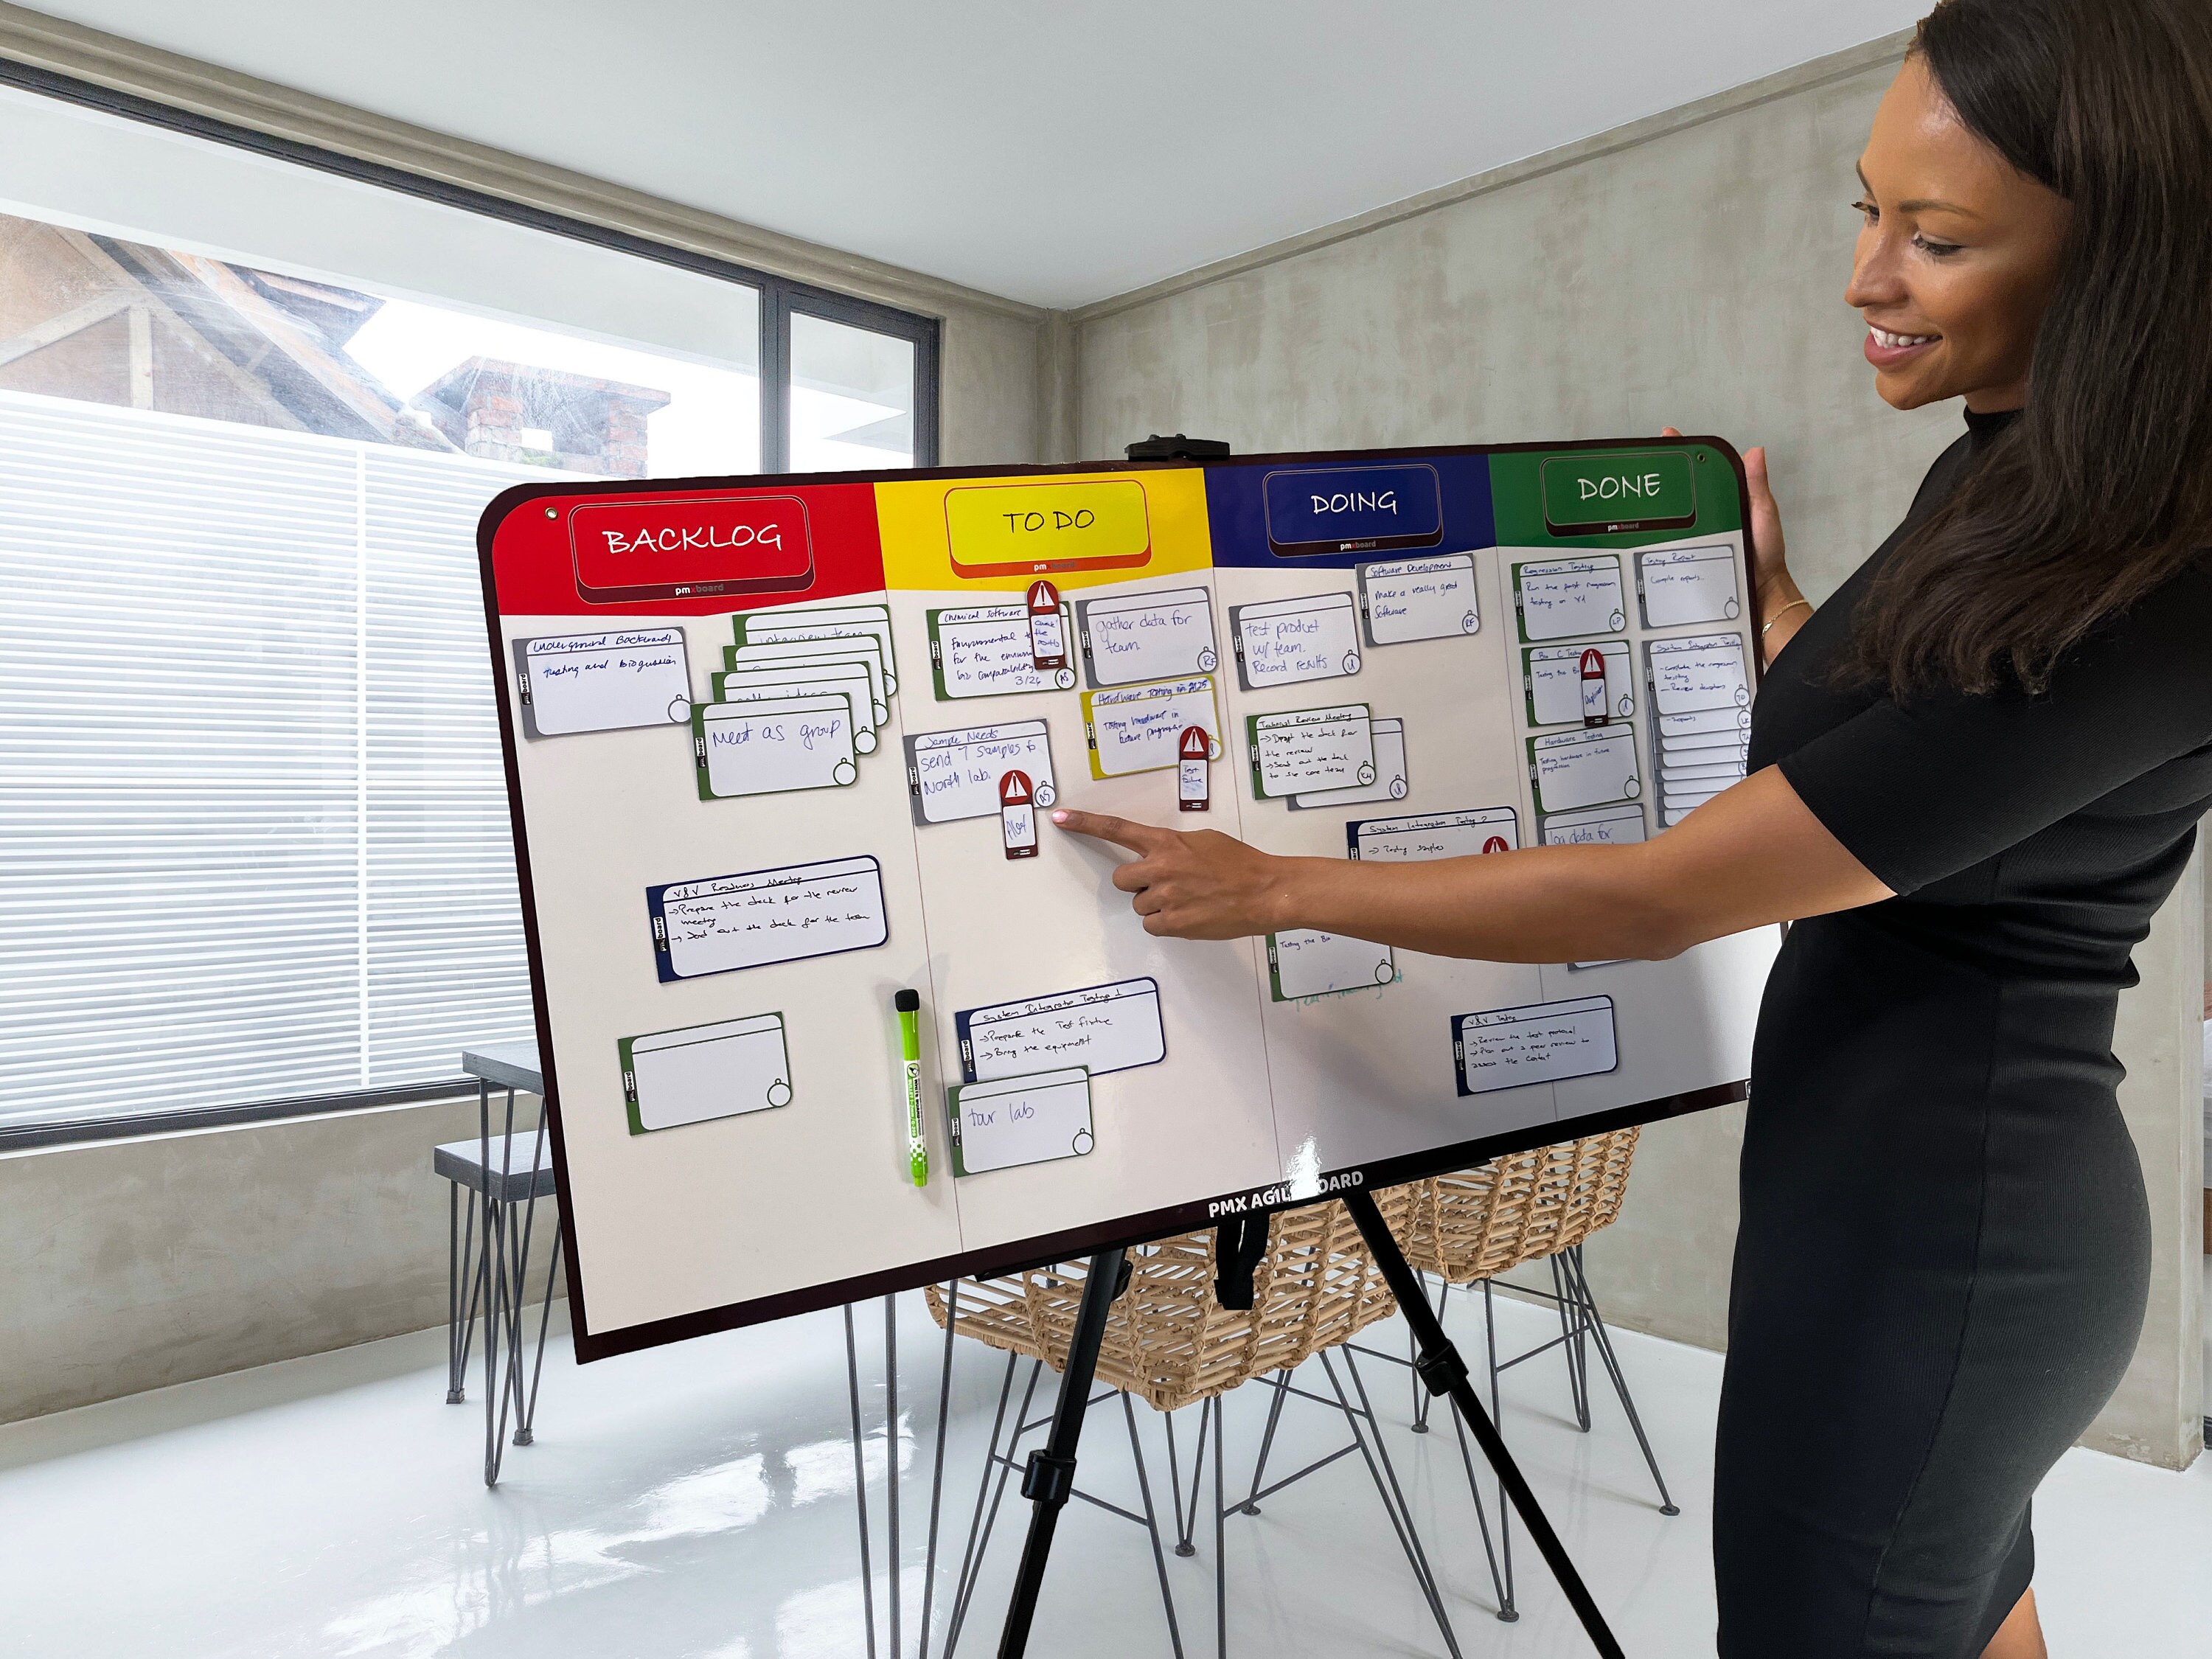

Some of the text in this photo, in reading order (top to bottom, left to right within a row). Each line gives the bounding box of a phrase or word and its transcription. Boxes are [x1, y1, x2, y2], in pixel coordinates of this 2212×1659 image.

[1578, 473, 1660, 501] DONE
[1311, 491, 1398, 515] DOING
[1002, 509, 1095, 534] TO DO
[602, 524, 782, 554] BACKLOG
[1340, 540, 1376, 551] pmxboard
[675, 583, 724, 596] pmxboard
[1096, 609, 1192, 642] gather data for
[1276, 619, 1320, 639] product
[585, 659, 609, 669] and
[974, 653, 991, 662] the
[800, 720, 840, 751] group
[1597, 824, 1613, 841] for
[721, 901, 740, 910] the
[748, 896, 776, 905] deck
[785, 895, 799, 905] for
[804, 890, 821, 900] the
[770, 918, 796, 929] deck
[801, 917, 819, 928] for
[824, 914, 838, 923] the
[1304, 937, 1315, 945] the
[1032, 1027, 1046, 1035] the
[1024, 1044, 1040, 1053] the
[1009, 1101, 1034, 1123] lab
[1208, 1171, 1364, 1217] PMX AGIL OARD
